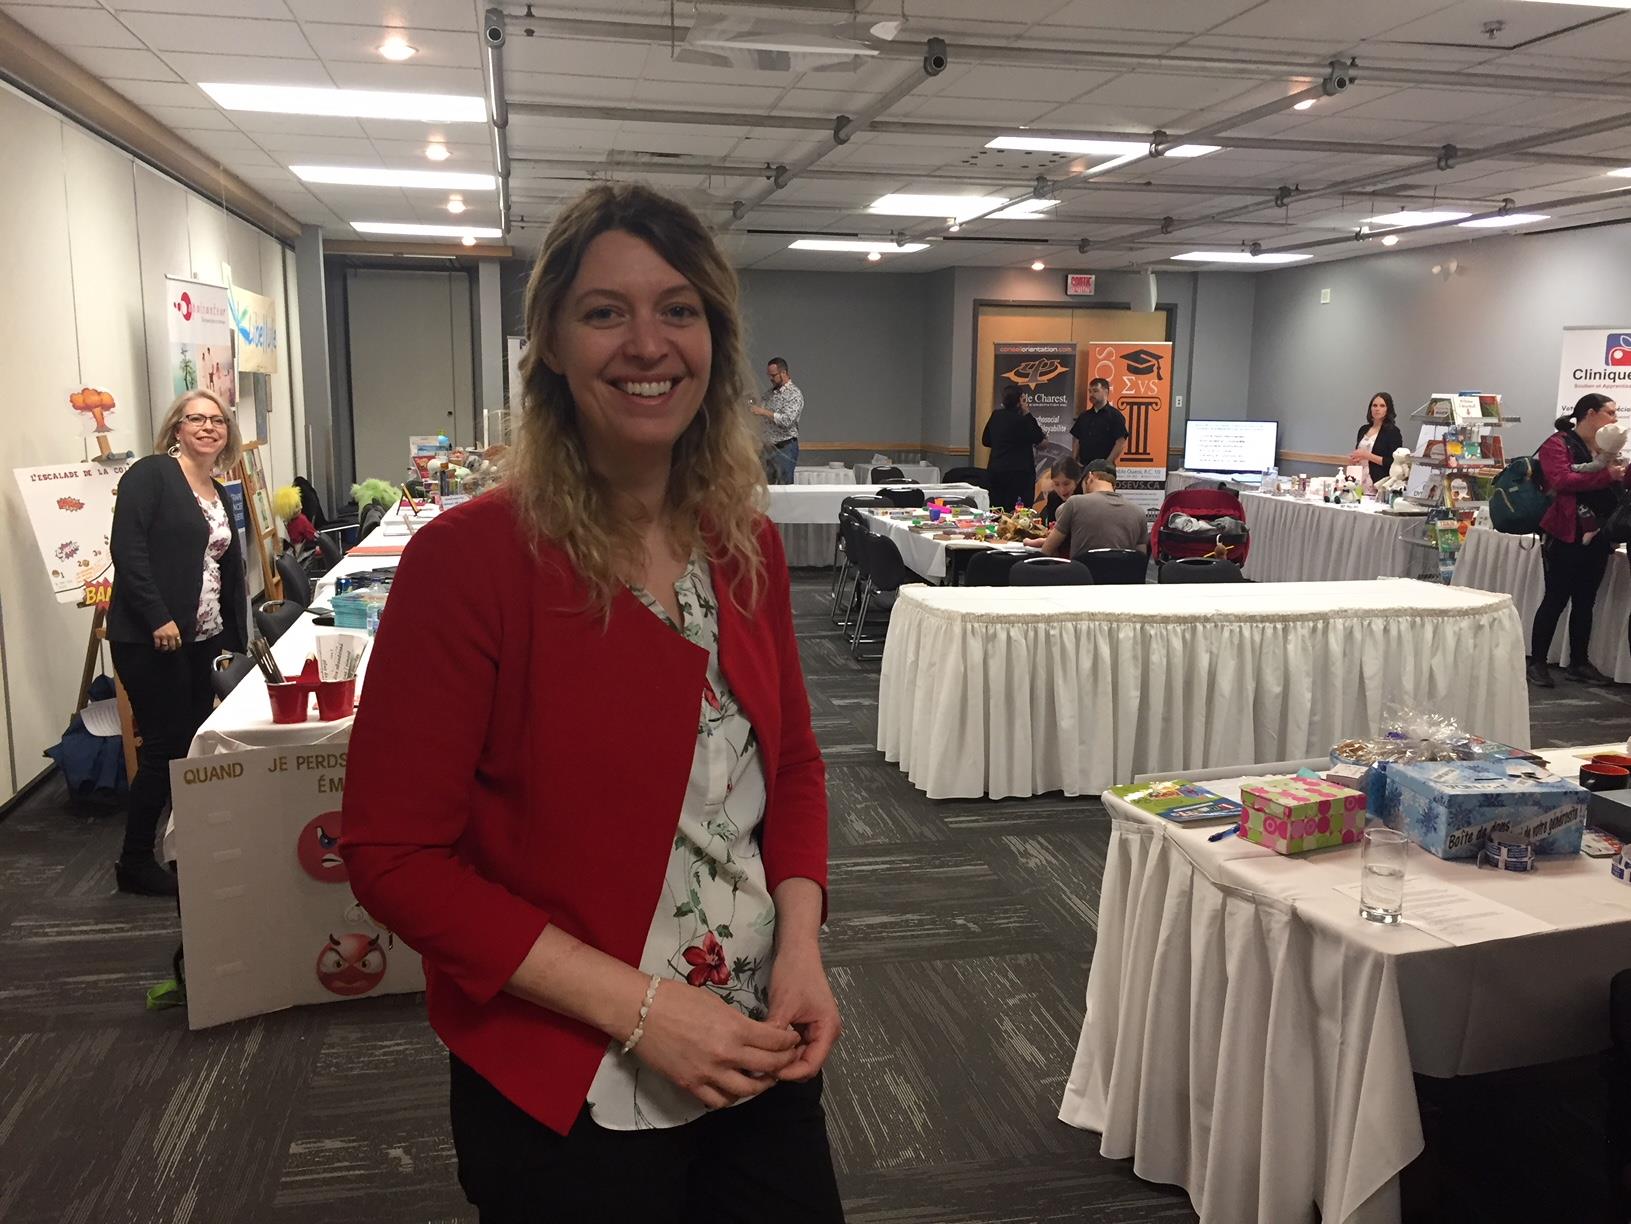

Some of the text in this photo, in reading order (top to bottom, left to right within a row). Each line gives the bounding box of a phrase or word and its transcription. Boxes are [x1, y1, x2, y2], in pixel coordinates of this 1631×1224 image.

[30, 470, 79, 482] L'ESCALADE
[83, 468, 92, 477] DE
[97, 467, 109, 476] LA
[1115, 480, 1160, 489] OSEVS.CA
[183, 752, 348, 785] QUAND JE PERDS
[318, 774, 345, 793] ÉM
[1448, 829, 1473, 850] Boîte
